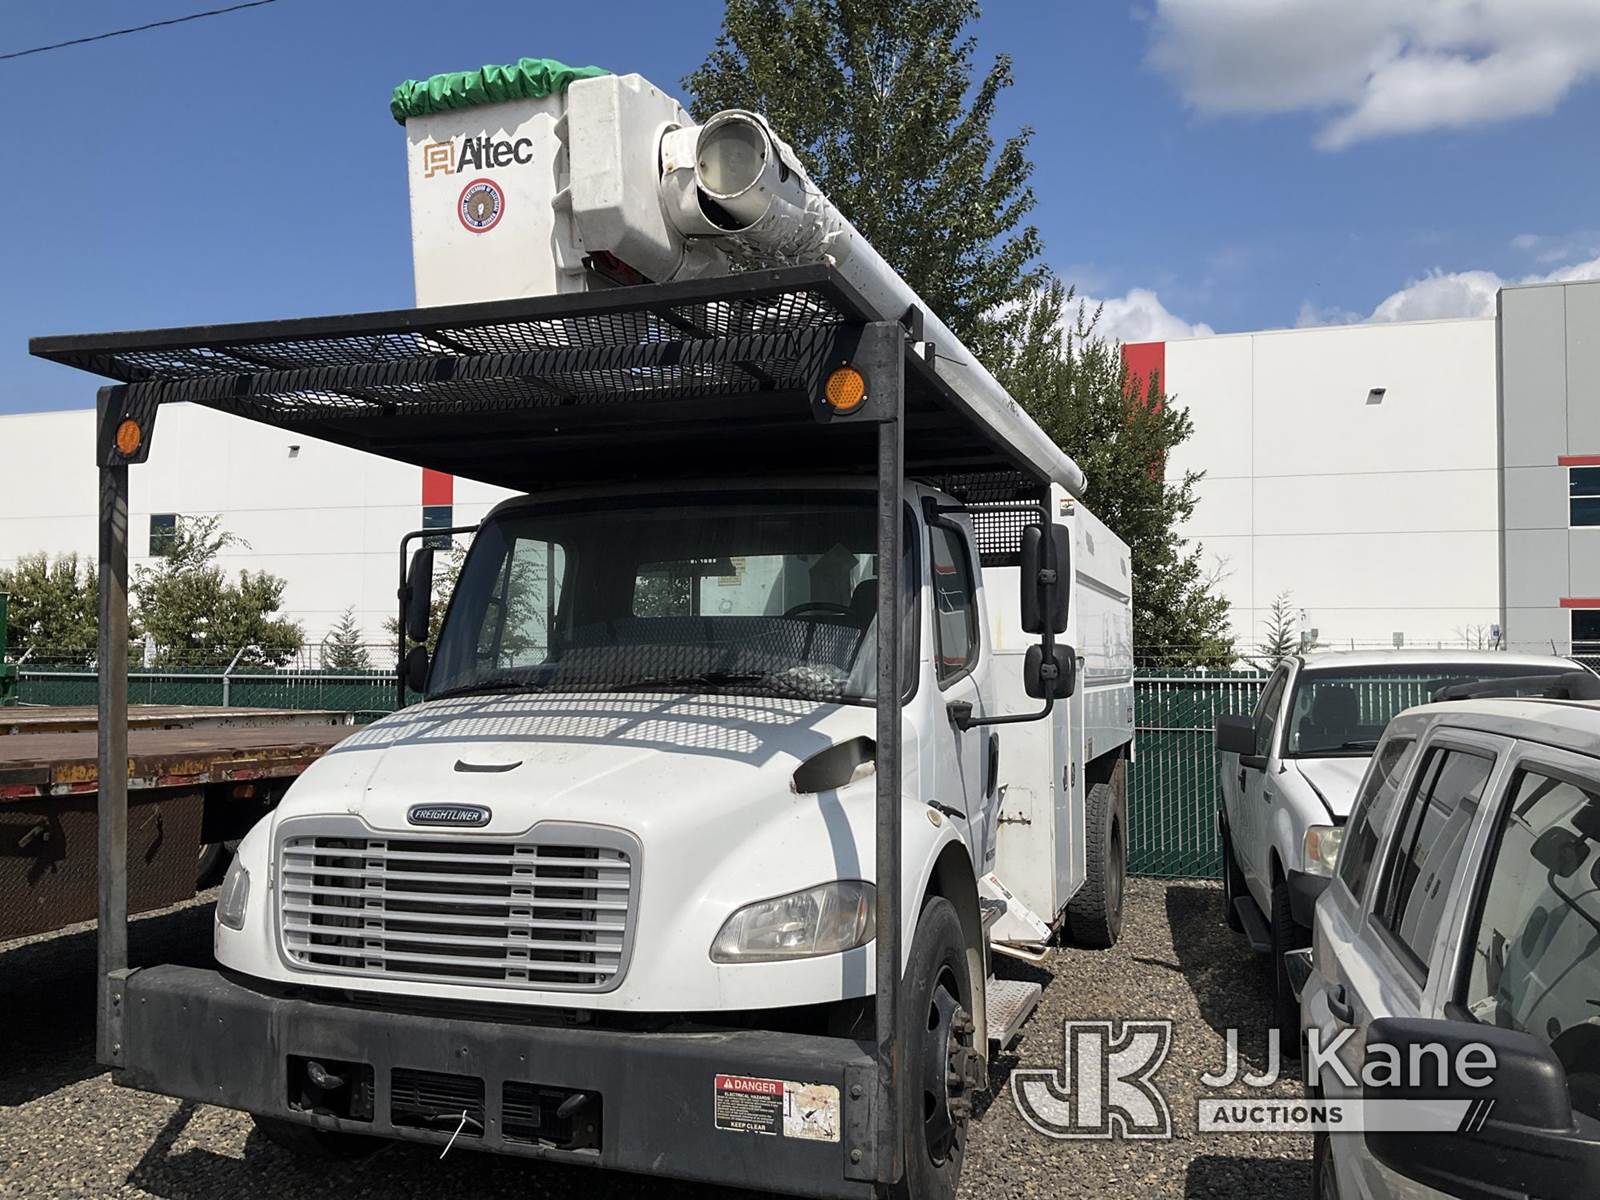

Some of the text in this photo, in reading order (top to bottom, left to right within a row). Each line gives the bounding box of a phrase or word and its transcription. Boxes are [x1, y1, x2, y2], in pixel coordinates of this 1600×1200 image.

[456, 137, 532, 173] Altec
[415, 810, 478, 820] FREIGHTLINER
[734, 1080, 775, 1092] DANGER
